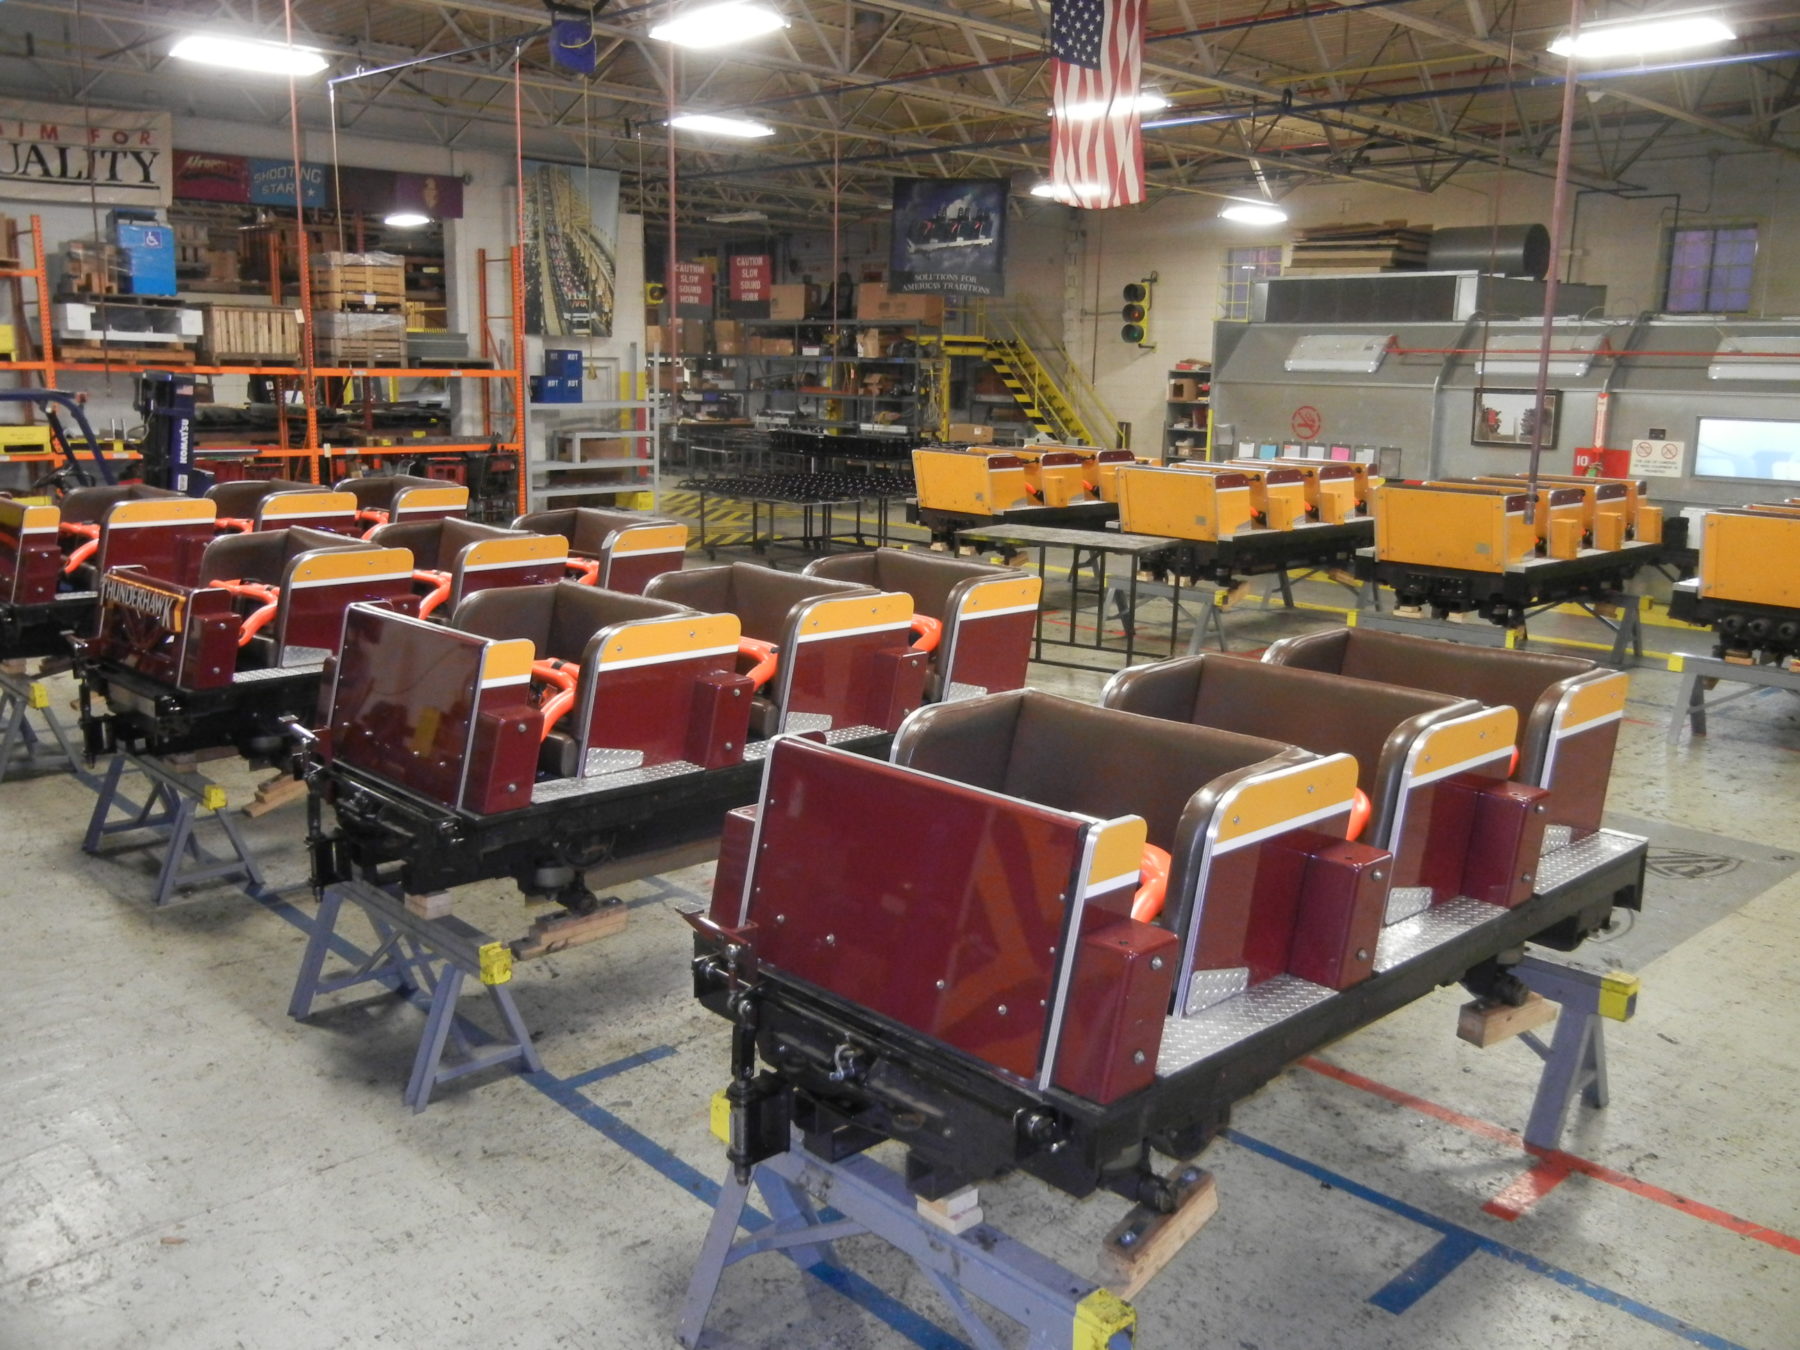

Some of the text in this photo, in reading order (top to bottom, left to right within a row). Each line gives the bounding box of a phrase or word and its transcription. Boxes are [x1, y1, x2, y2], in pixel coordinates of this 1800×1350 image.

[0, 122, 152, 145] IM FOR
[254, 165, 322, 184] SHOOTNG
[262, 183, 295, 195] STAR
[736, 255, 763, 267] CAUTION
[674, 263, 704, 274] CAUTION
[742, 268, 758, 278] SLOW
[680, 275, 699, 285] SLOW
[914, 273, 977, 283] SOLUTIONS FOR
[679, 285, 702, 295] SOUND
[740, 279, 761, 290] SOUND
[944, 282, 991, 295] TRADITIONS
[680, 295, 699, 304] HORN
[741, 292, 759, 302] HORN
[179, 418, 189, 464] KOMATSU
[1576, 455, 1589, 467] 10
[100, 574, 175, 630] THUNDERHAWK
